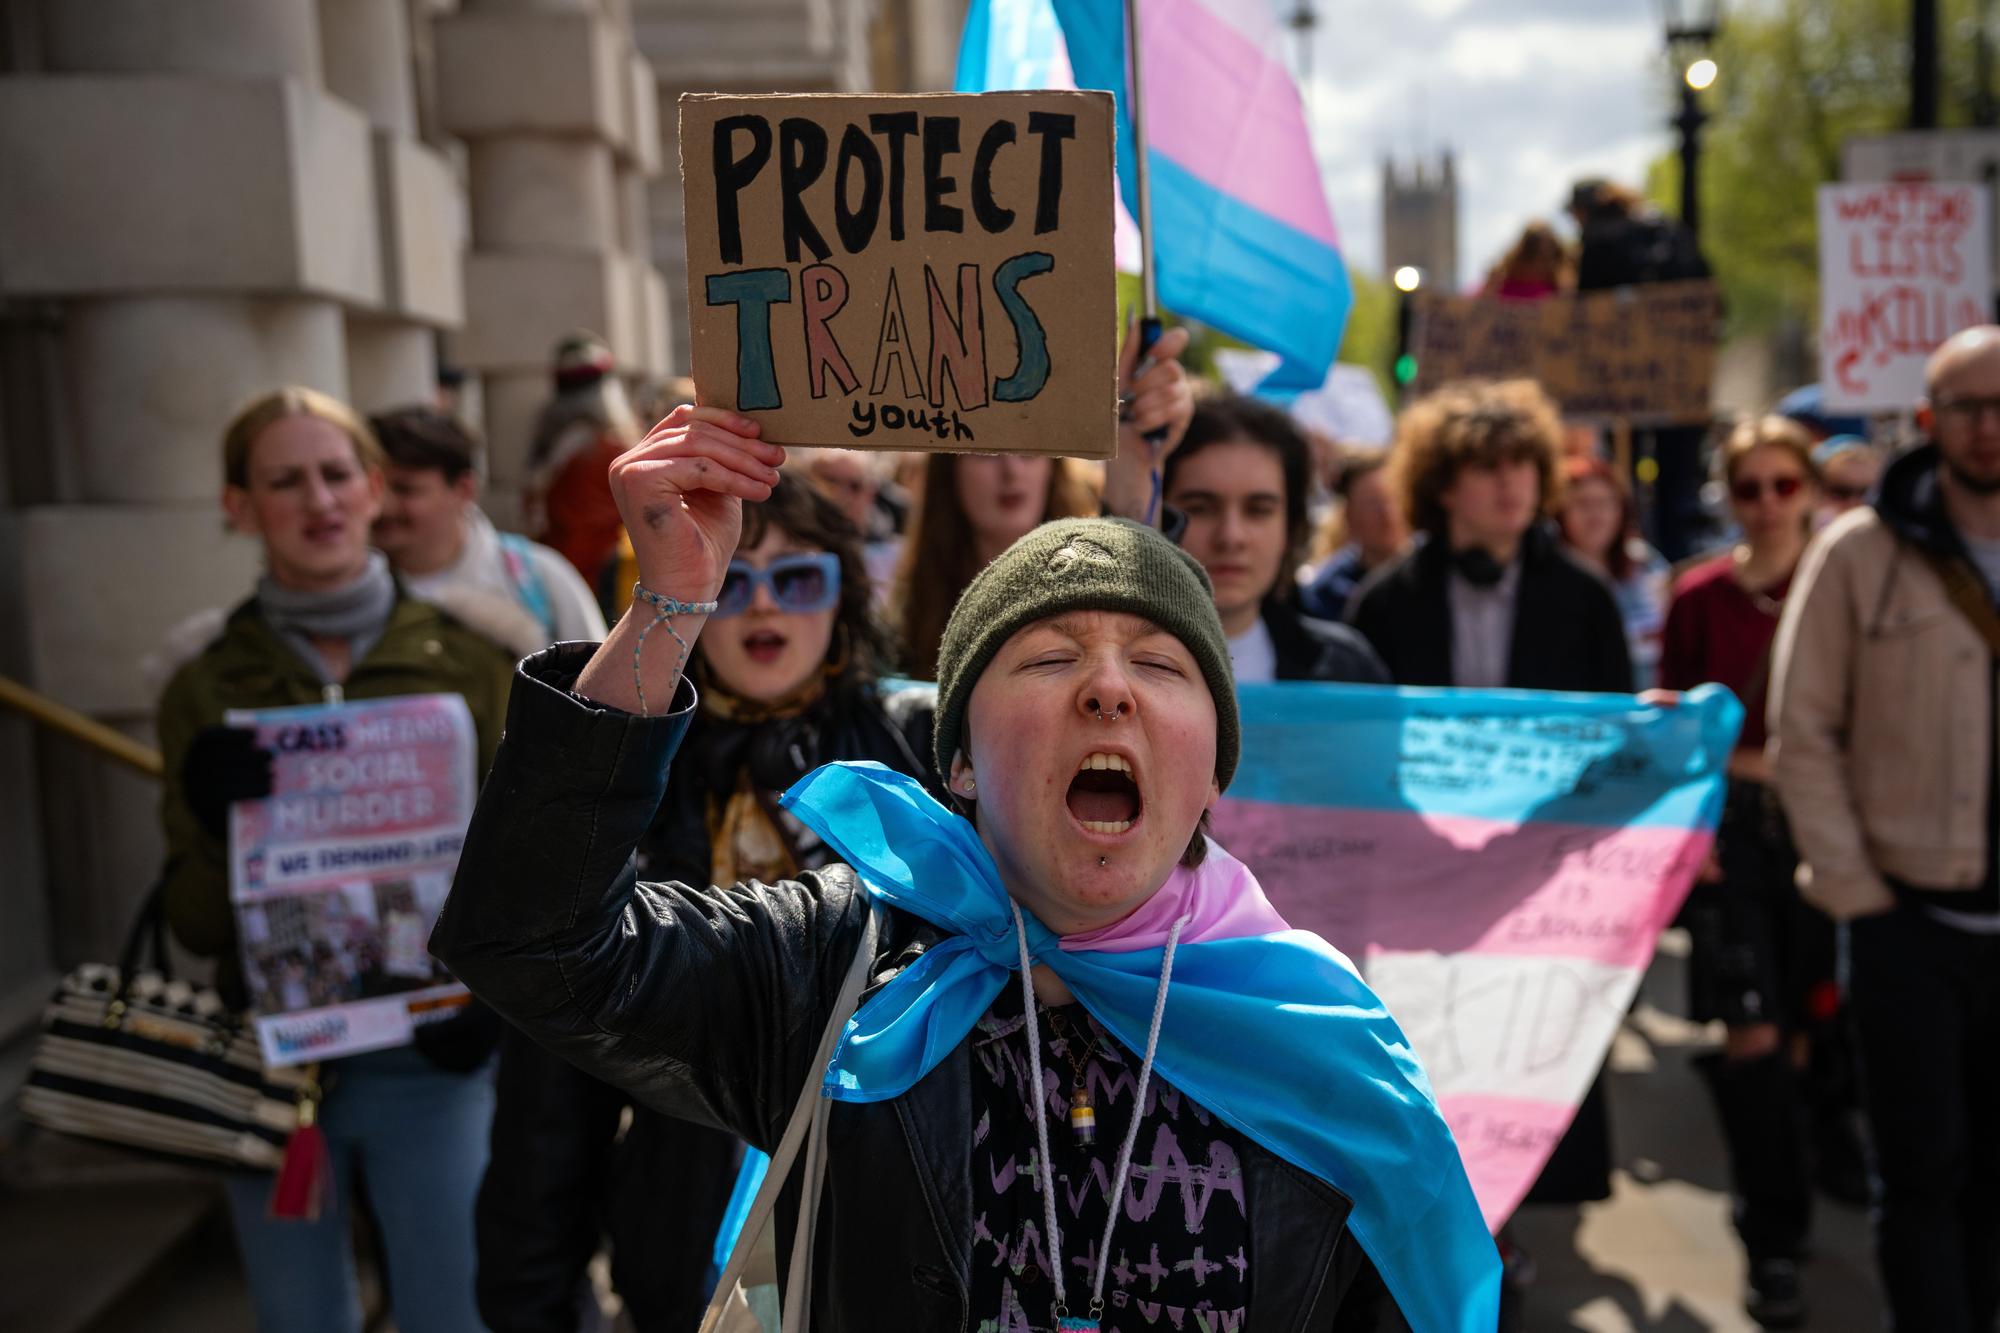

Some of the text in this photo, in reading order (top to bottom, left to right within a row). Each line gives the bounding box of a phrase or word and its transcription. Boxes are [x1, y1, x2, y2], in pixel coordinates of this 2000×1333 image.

[712, 111, 1076, 265] PROTECT
[1850, 228, 1966, 286] LISTS
[705, 252, 1055, 412] TRANS
[847, 399, 974, 441] youth
[278, 712, 452, 751] CASS MEANS
[305, 749, 426, 790] SOCIAL
[271, 784, 436, 833] MURDER
[279, 854, 310, 876] WE
[318, 842, 412, 869] DEMAND
